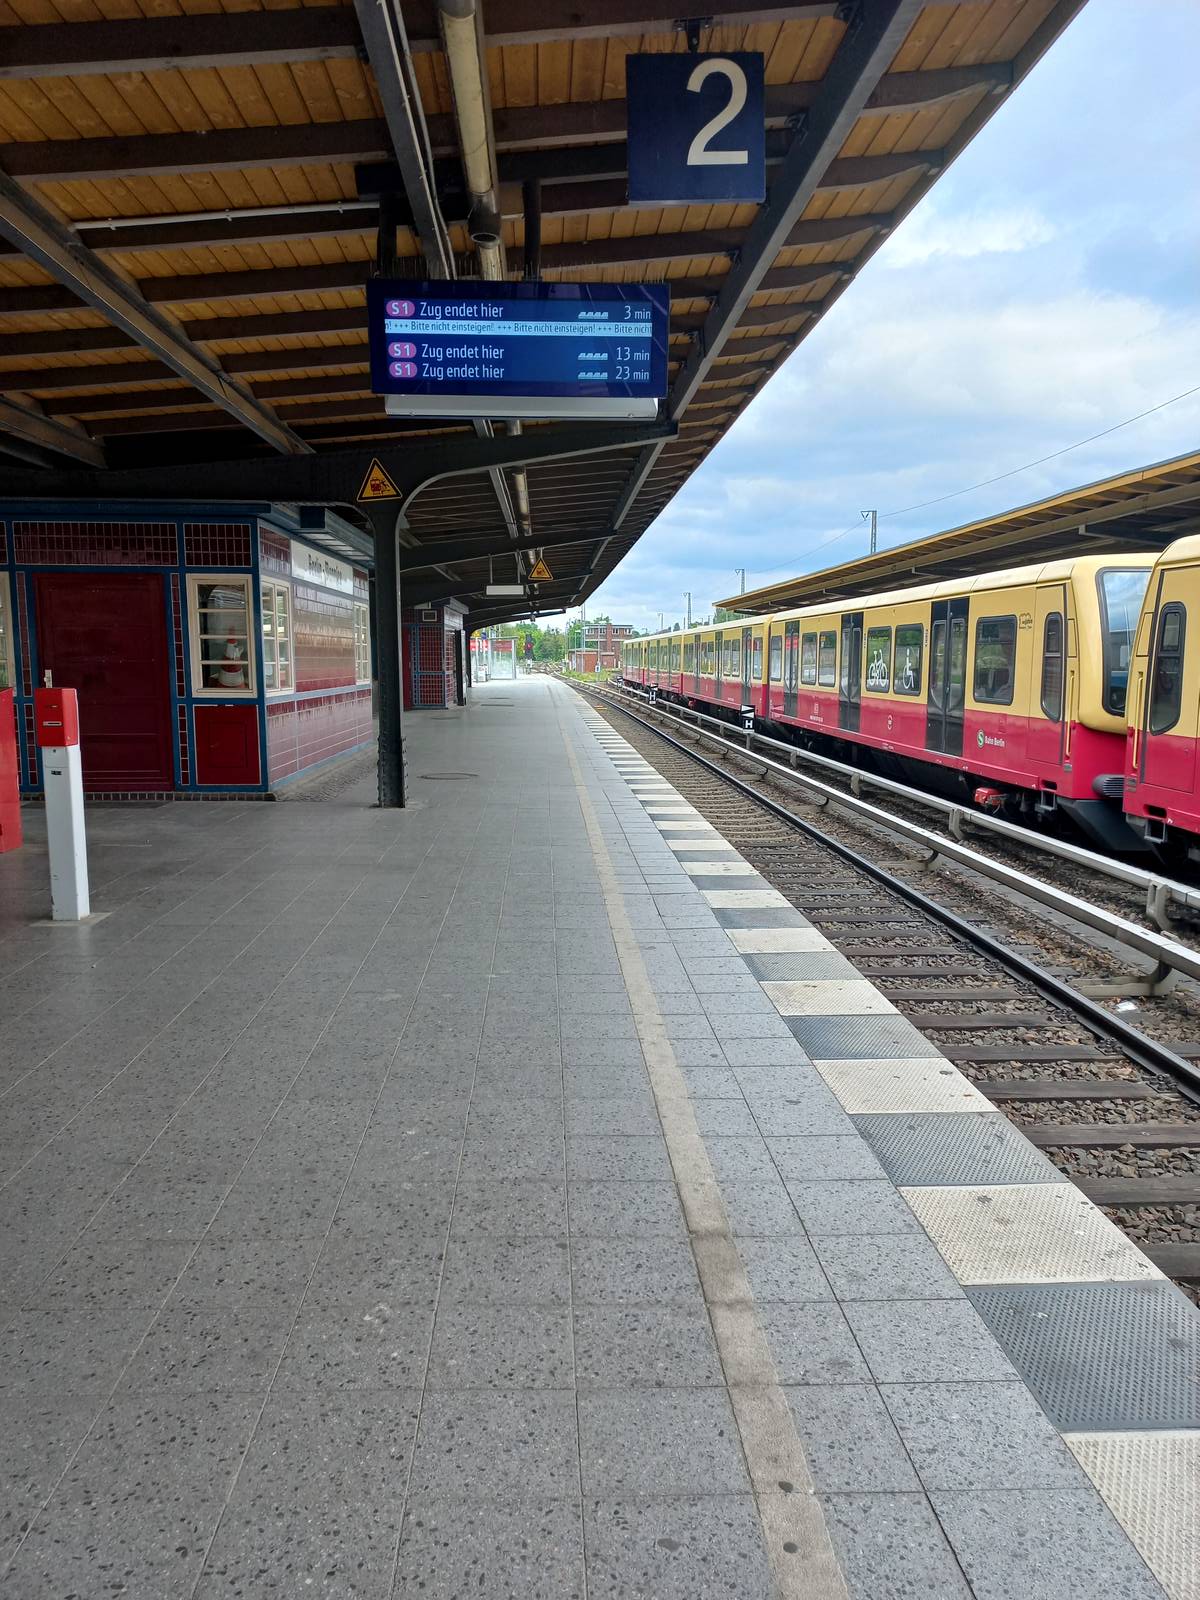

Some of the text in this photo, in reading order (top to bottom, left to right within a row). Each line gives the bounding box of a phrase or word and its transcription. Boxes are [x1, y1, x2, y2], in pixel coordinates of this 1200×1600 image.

[686, 57, 749, 166] 2
[420, 302, 442, 320] Zug
[444, 303, 478, 317] endet
[481, 303, 504, 317] hier
[624, 305, 631, 320] 3
[634, 308, 651, 320] min
[411, 321, 430, 331] Bitte
[431, 321, 451, 331] nicht
[514, 323, 532, 333] Bitte
[534, 323, 552, 333] nicht
[554, 324, 596, 335] einsteigen!
[614, 324, 632, 334] Bitte
[421, 344, 443, 361] Zug
[445, 345, 479, 359] endet
[481, 345, 504, 359] hier
[616, 347, 631, 361] 13
[633, 349, 650, 361] min
[422, 363, 444, 380] Zug
[446, 364, 479, 378] endet
[482, 364, 504, 378] hier
[615, 366, 630, 380] 23
[633, 369, 649, 380] min
[649, 691, 656, 700] H
[745, 719, 753, 728] H
